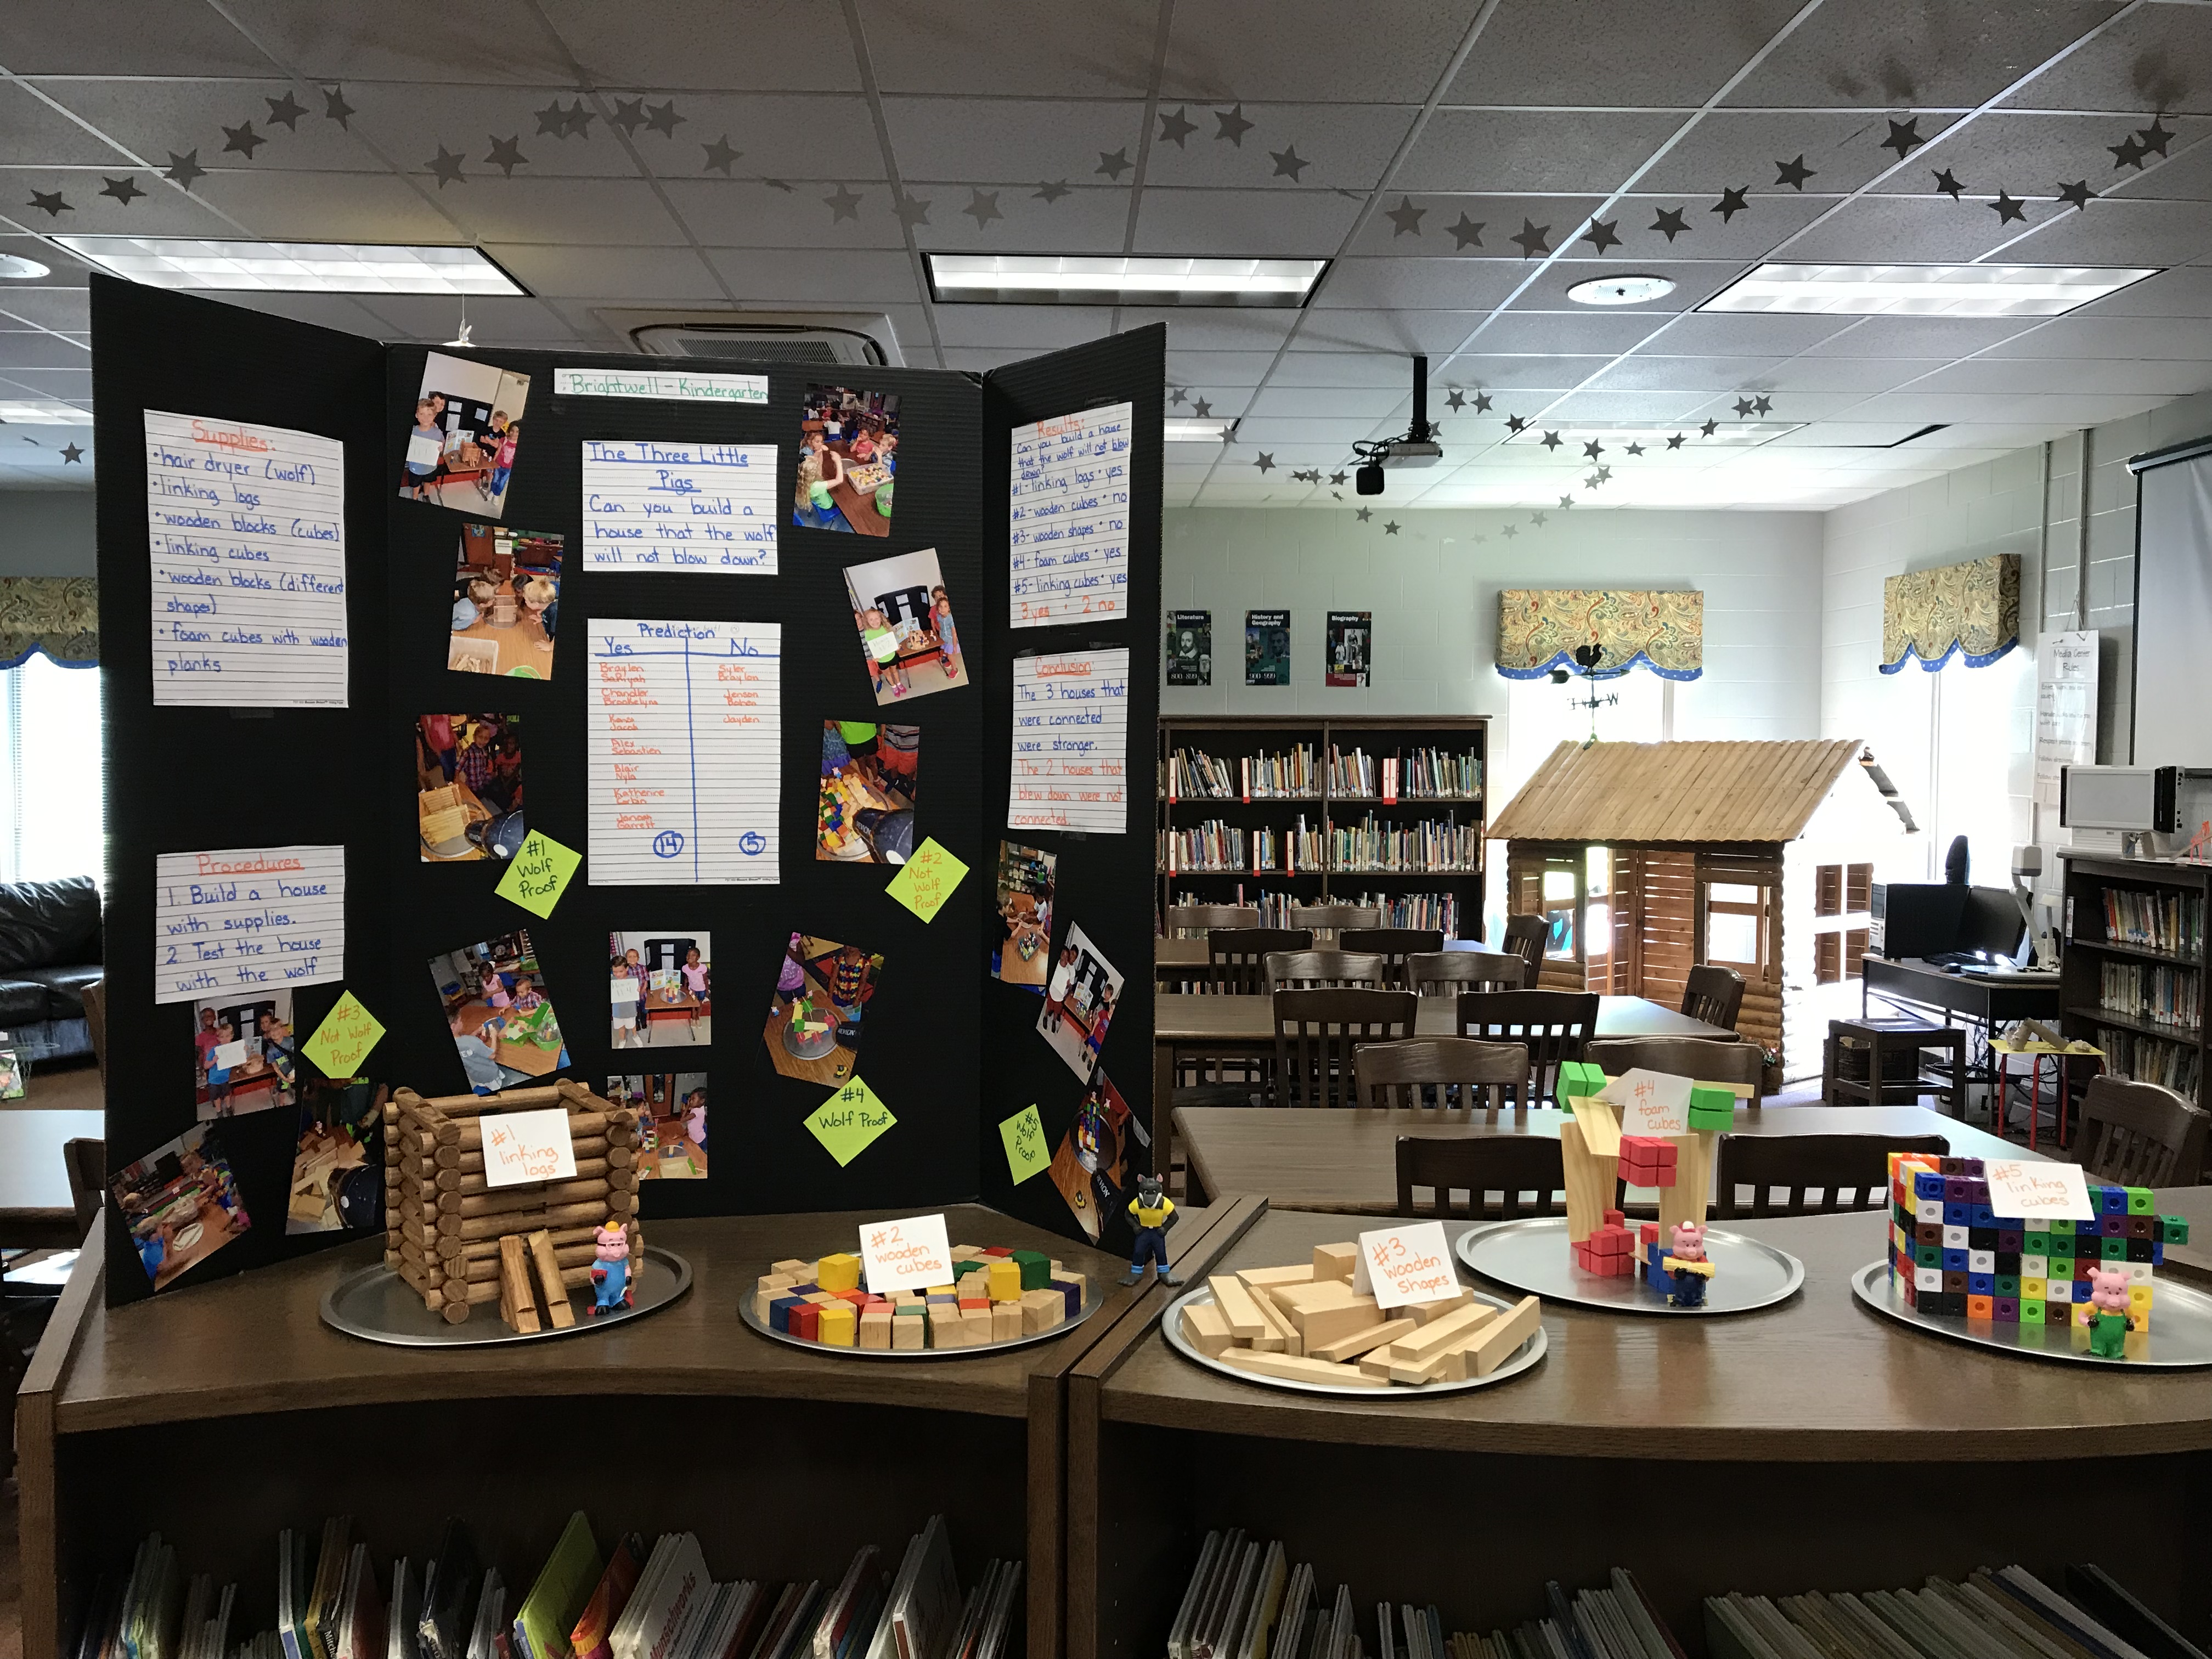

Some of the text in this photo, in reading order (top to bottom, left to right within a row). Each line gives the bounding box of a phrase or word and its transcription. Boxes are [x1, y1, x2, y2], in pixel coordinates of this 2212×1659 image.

[569, 374, 768, 402] Brightwell Kindergarten
[192, 419, 276, 452] Supplies:
[1037, 415, 1085, 439] Results:
[1017, 443, 1032, 454] Can
[1038, 440, 1051, 455] you
[1061, 430, 1082, 443] build
[1098, 424, 1120, 435] house
[588, 442, 748, 464] The Three Little
[1018, 438, 1128, 467] that the wolf will not blow
[161, 446, 315, 485] hair dryer (wolf)
[1022, 464, 1045, 479] down?
[656, 470, 693, 495] Pigs
[1032, 466, 1122, 494] linking logs yes
[161, 475, 261, 510] linking logs
[589, 494, 753, 518] Can you build a
[1034, 493, 1127, 517] wooden cubes no
[165, 514, 339, 541] wooden blocks (cubes)
[594, 521, 776, 541] house that the wolf
[1033, 520, 1122, 543] wooden shapes no
[166, 535, 269, 564] linking cubes
[594, 546, 766, 565] will not blow down?
[1034, 547, 1121, 567] foam cubes yes
[168, 568, 343, 594] wooden blocks (different
[1036, 571, 1127, 596] linking cubes yes
[166, 594, 216, 618] shapes)
[1021, 595, 1115, 625] 3 yes 2 no
[172, 622, 347, 647] foam cubes with wooden
[637, 623, 715, 640] Prediction
[604, 636, 758, 656] Yes No
[2054, 650, 2072, 658] Media
[168, 654, 222, 676] planks
[2063, 663, 2079, 672] Rules
[1018, 679, 1125, 701] The 3 houses that
[723, 714, 759, 726] Jayden
[1019, 706, 1102, 726] were connected
[1018, 733, 1098, 757] were stronger.
[614, 764, 639, 772] Blair
[1018, 758, 1122, 776] The 2 houses that
[1019, 783, 1122, 802] blew down were not
[527, 839, 544, 857] #1
[921, 850, 942, 864] #2
[196, 853, 302, 876] Procedures
[516, 857, 552, 878] Wolf
[909, 867, 933, 879] Not
[190, 882, 237, 904] Build
[249, 889, 261, 900] a
[278, 879, 328, 897] house
[518, 875, 557, 899] Proof
[914, 878, 940, 892] Wolf
[914, 892, 941, 910] Proof
[167, 909, 296, 935] with supplies.
[193, 941, 224, 960] Test
[235, 939, 263, 956] the
[277, 935, 321, 952] house
[176, 956, 318, 991] with the wolf
[337, 1004, 360, 1022] #3
[321, 1022, 371, 1045] Not Wolf
[330, 1041, 362, 1066] Proof
[840, 1087, 864, 1103] #4
[1634, 1080, 1654, 1097] #4
[1639, 1099, 1669, 1116] foam
[819, 1110, 888, 1129] Wolf Proof
[1025, 1111, 1039, 1131] #5
[1647, 1117, 1680, 1130] cubes
[491, 1124, 515, 1147] #1
[1017, 1120, 1035, 1142] Wolf
[499, 1144, 558, 1165] linking
[522, 1162, 556, 1179] logs
[1993, 1164, 2022, 1181] #5
[2006, 1176, 2068, 1194] linking
[2021, 1195, 2069, 1207] cubes
[871, 1226, 903, 1248] #2
[876, 1243, 930, 1263] wooden
[1373, 1238, 1406, 1266] #3
[896, 1259, 942, 1274] cubes
[1384, 1251, 1441, 1279] wooden
